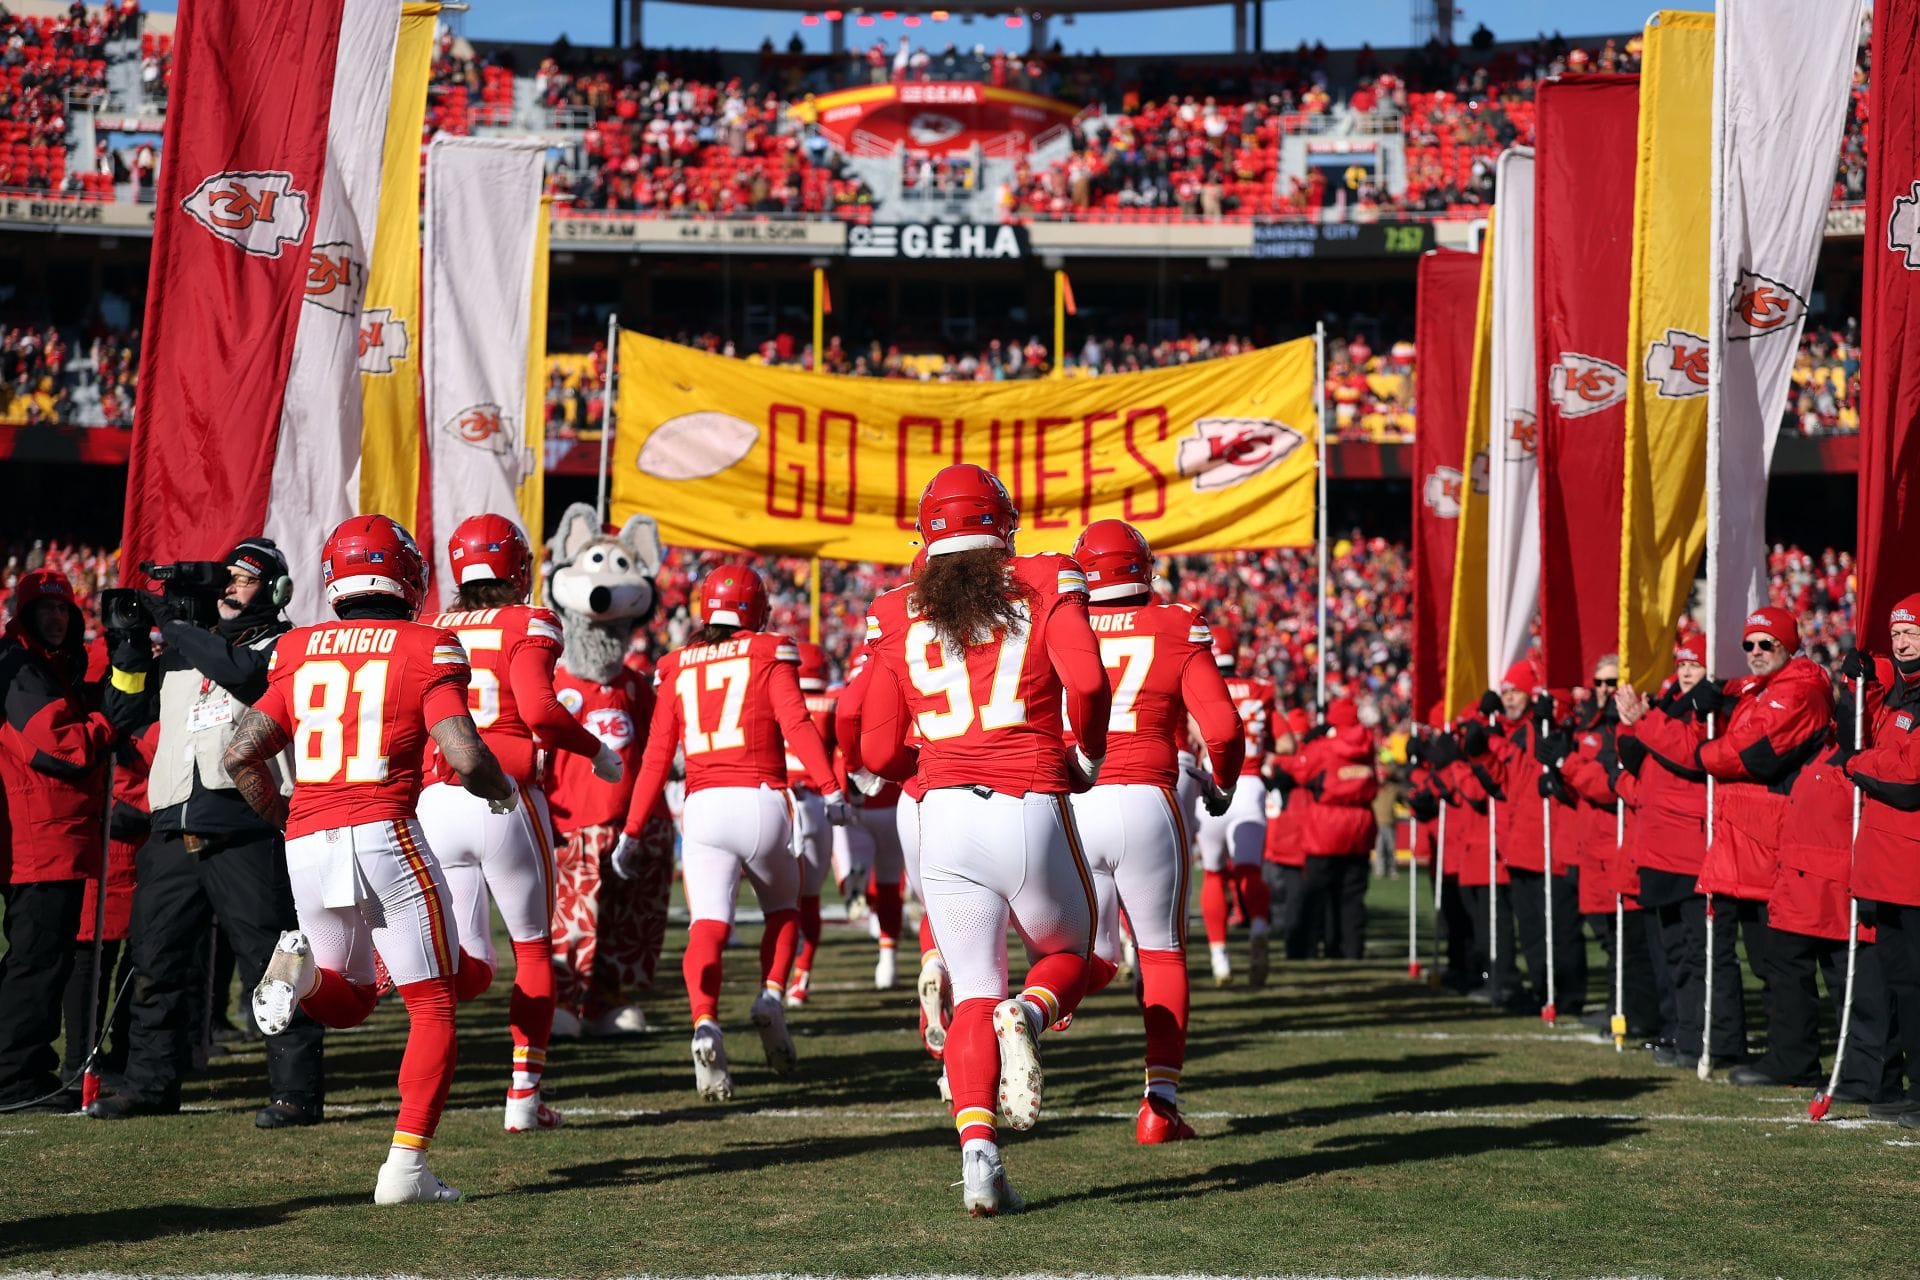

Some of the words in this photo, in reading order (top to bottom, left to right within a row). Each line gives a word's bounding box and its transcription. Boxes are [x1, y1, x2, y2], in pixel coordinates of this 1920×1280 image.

[1565, 367, 1615, 401] KC
[766, 402, 859, 527] GO
[305, 627, 398, 656] REMIGIO
[679, 638, 752, 668] MINSHEW
[1089, 610, 1138, 632] OORE
[905, 598, 1032, 742] 97
[293, 659, 390, 784] 81
[675, 656, 750, 757] 17
